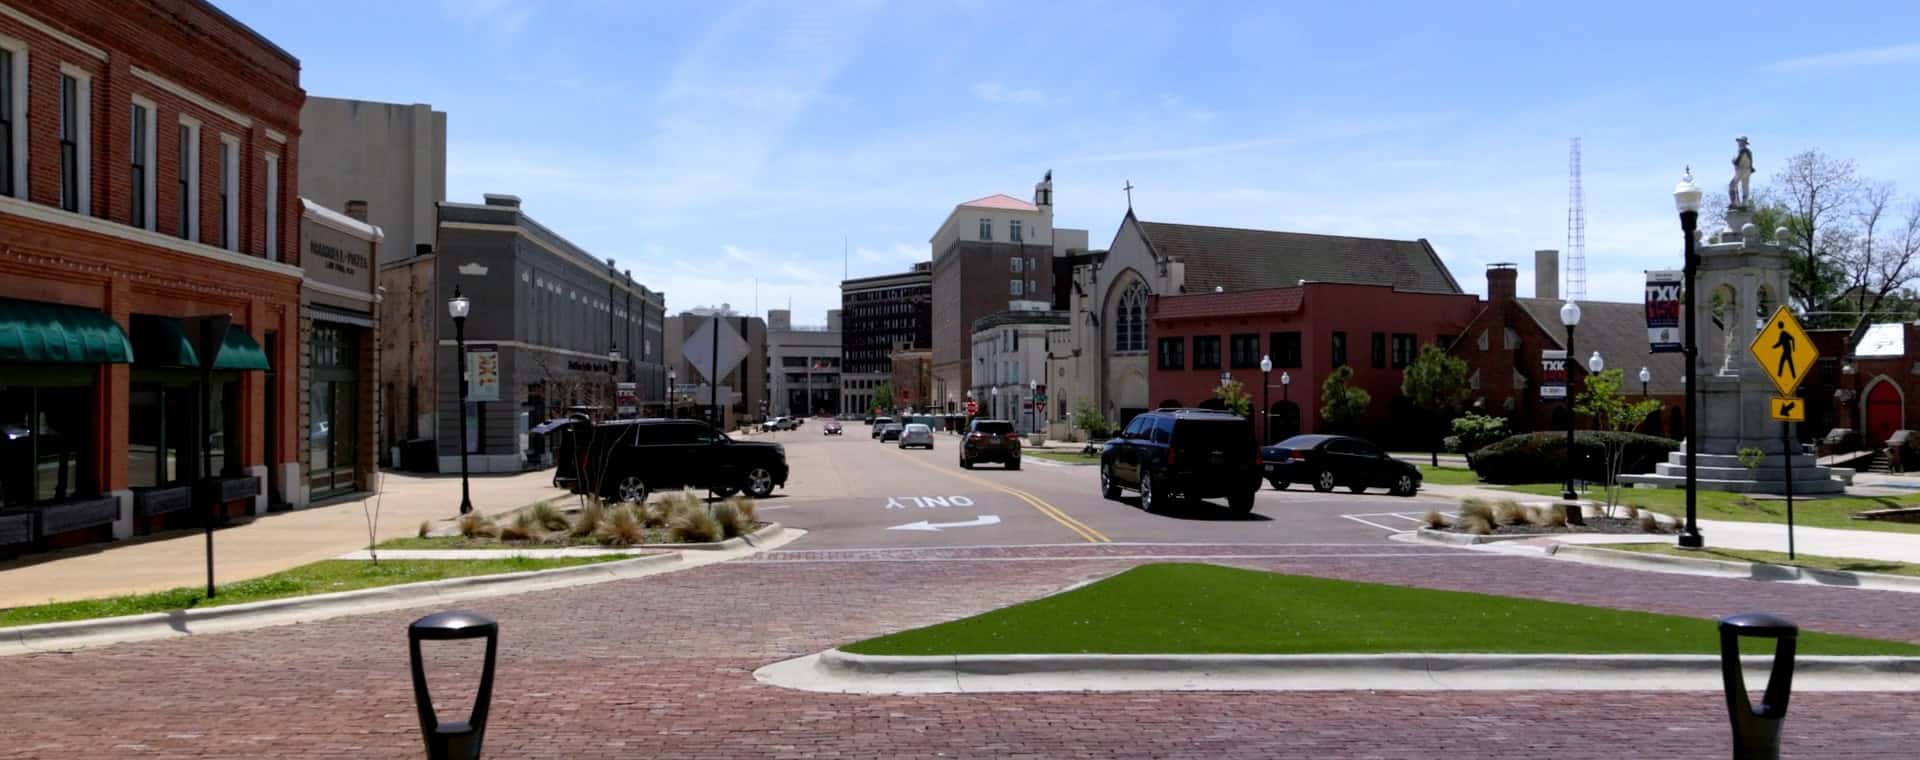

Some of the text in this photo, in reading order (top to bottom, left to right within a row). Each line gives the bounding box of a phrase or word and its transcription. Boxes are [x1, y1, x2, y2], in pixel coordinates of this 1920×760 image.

[1646, 286, 1680, 301] TXK
[1541, 361, 1565, 370] TXK
[885, 496, 974, 509] ONLY
